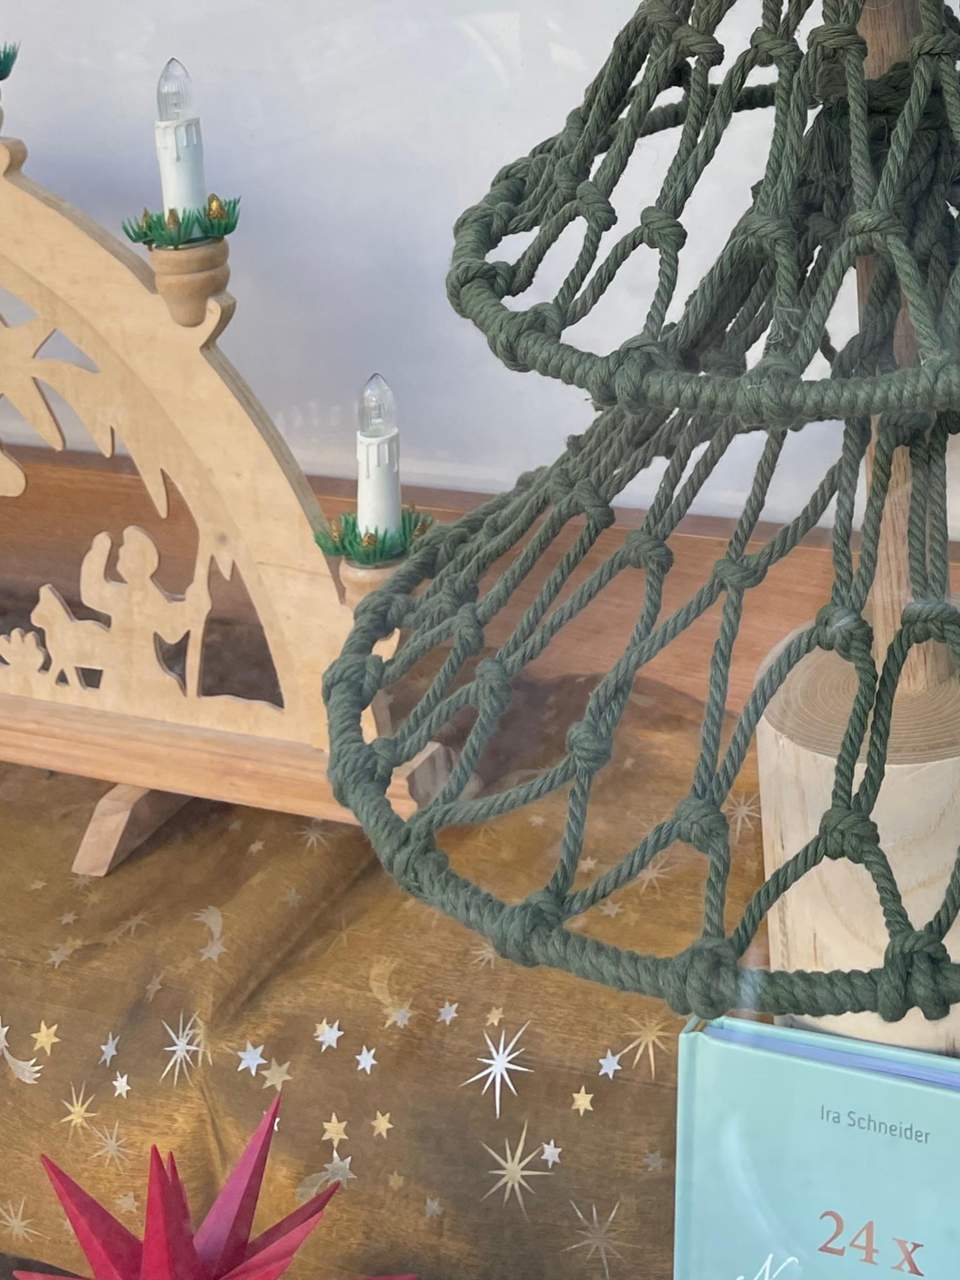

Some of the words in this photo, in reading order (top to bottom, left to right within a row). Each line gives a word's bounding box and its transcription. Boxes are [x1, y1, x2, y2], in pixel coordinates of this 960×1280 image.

[819, 1104, 842, 1125] Ira
[846, 1110, 931, 1145] Schneider
[818, 1210, 879, 1265] 24
[890, 1237, 925, 1278] x
